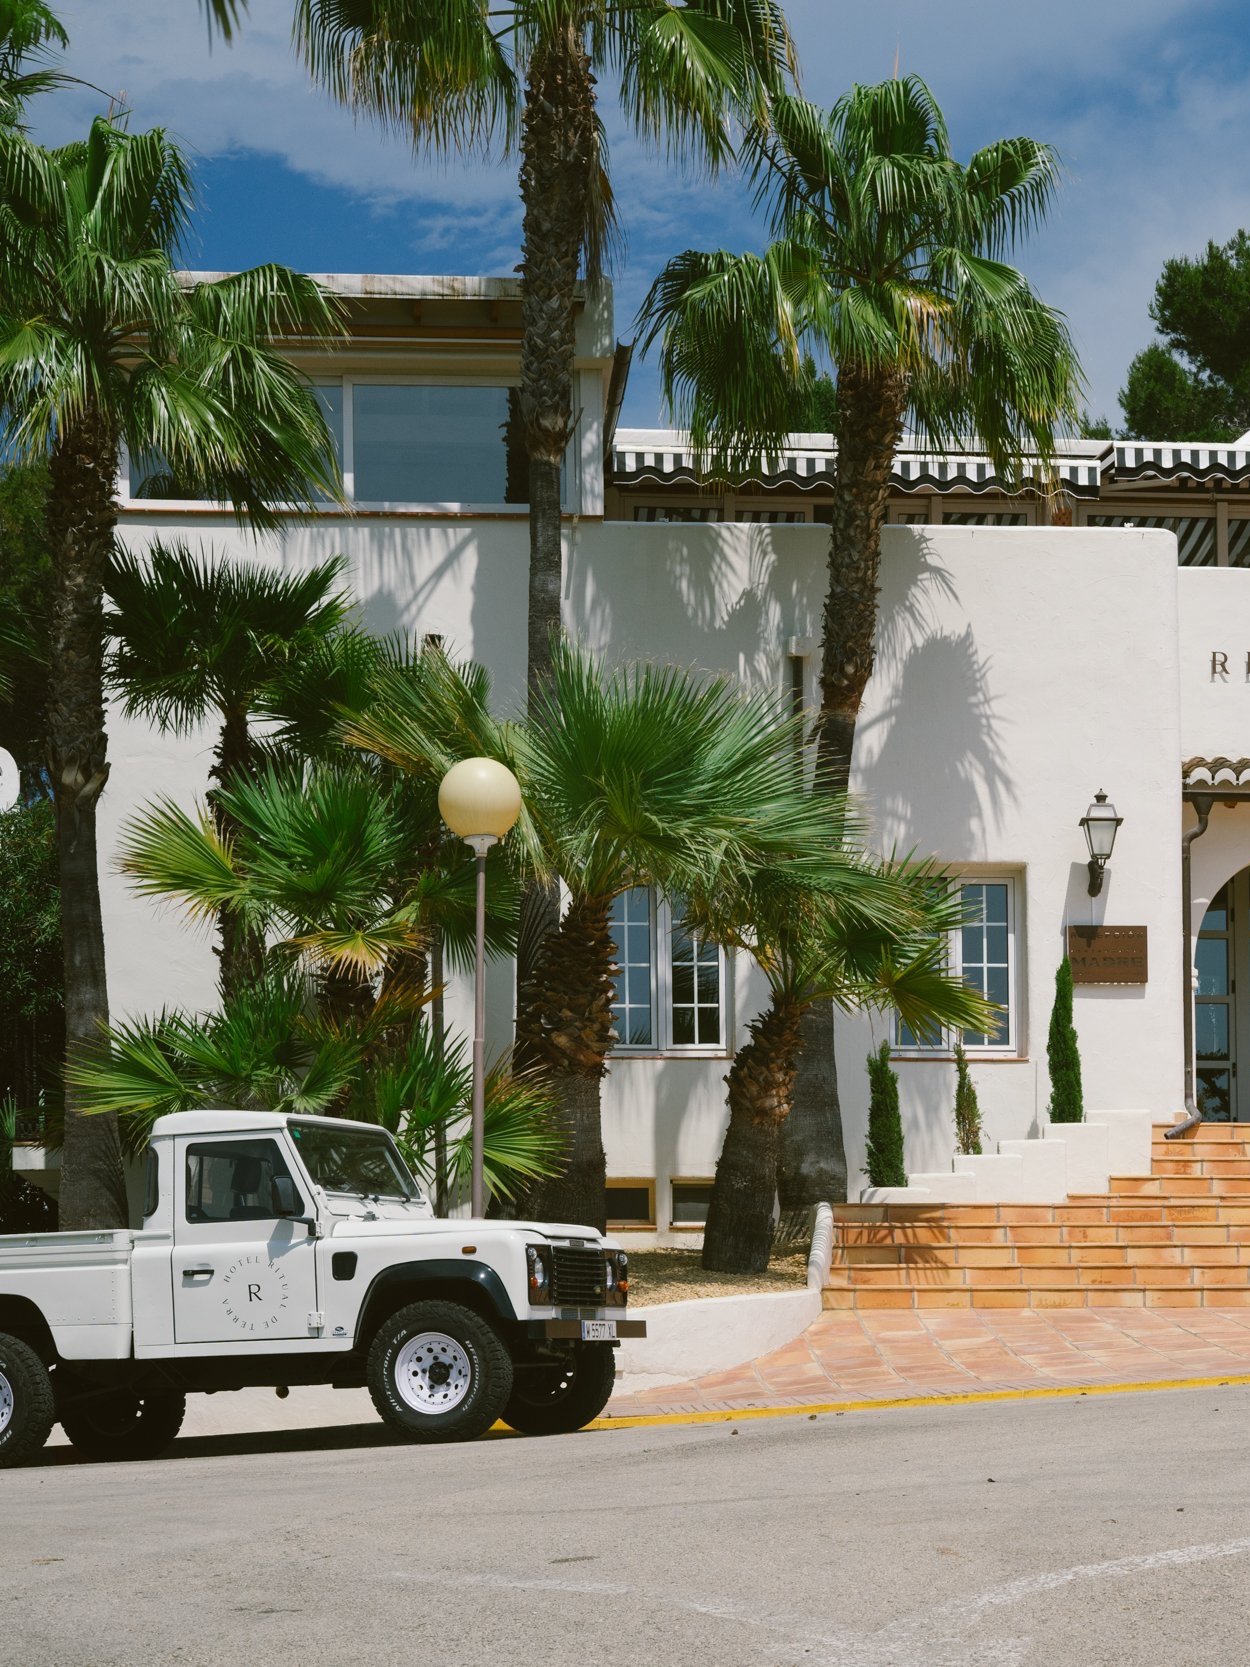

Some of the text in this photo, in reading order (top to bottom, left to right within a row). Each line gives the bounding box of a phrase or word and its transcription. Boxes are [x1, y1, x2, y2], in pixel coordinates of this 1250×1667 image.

[222, 1256, 289, 1331] HOTEL RITUAL DE TERRA
[248, 1283, 263, 1302] R
[393, 1329, 407, 1344] T/A
[592, 1323, 606, 1338] 5577
